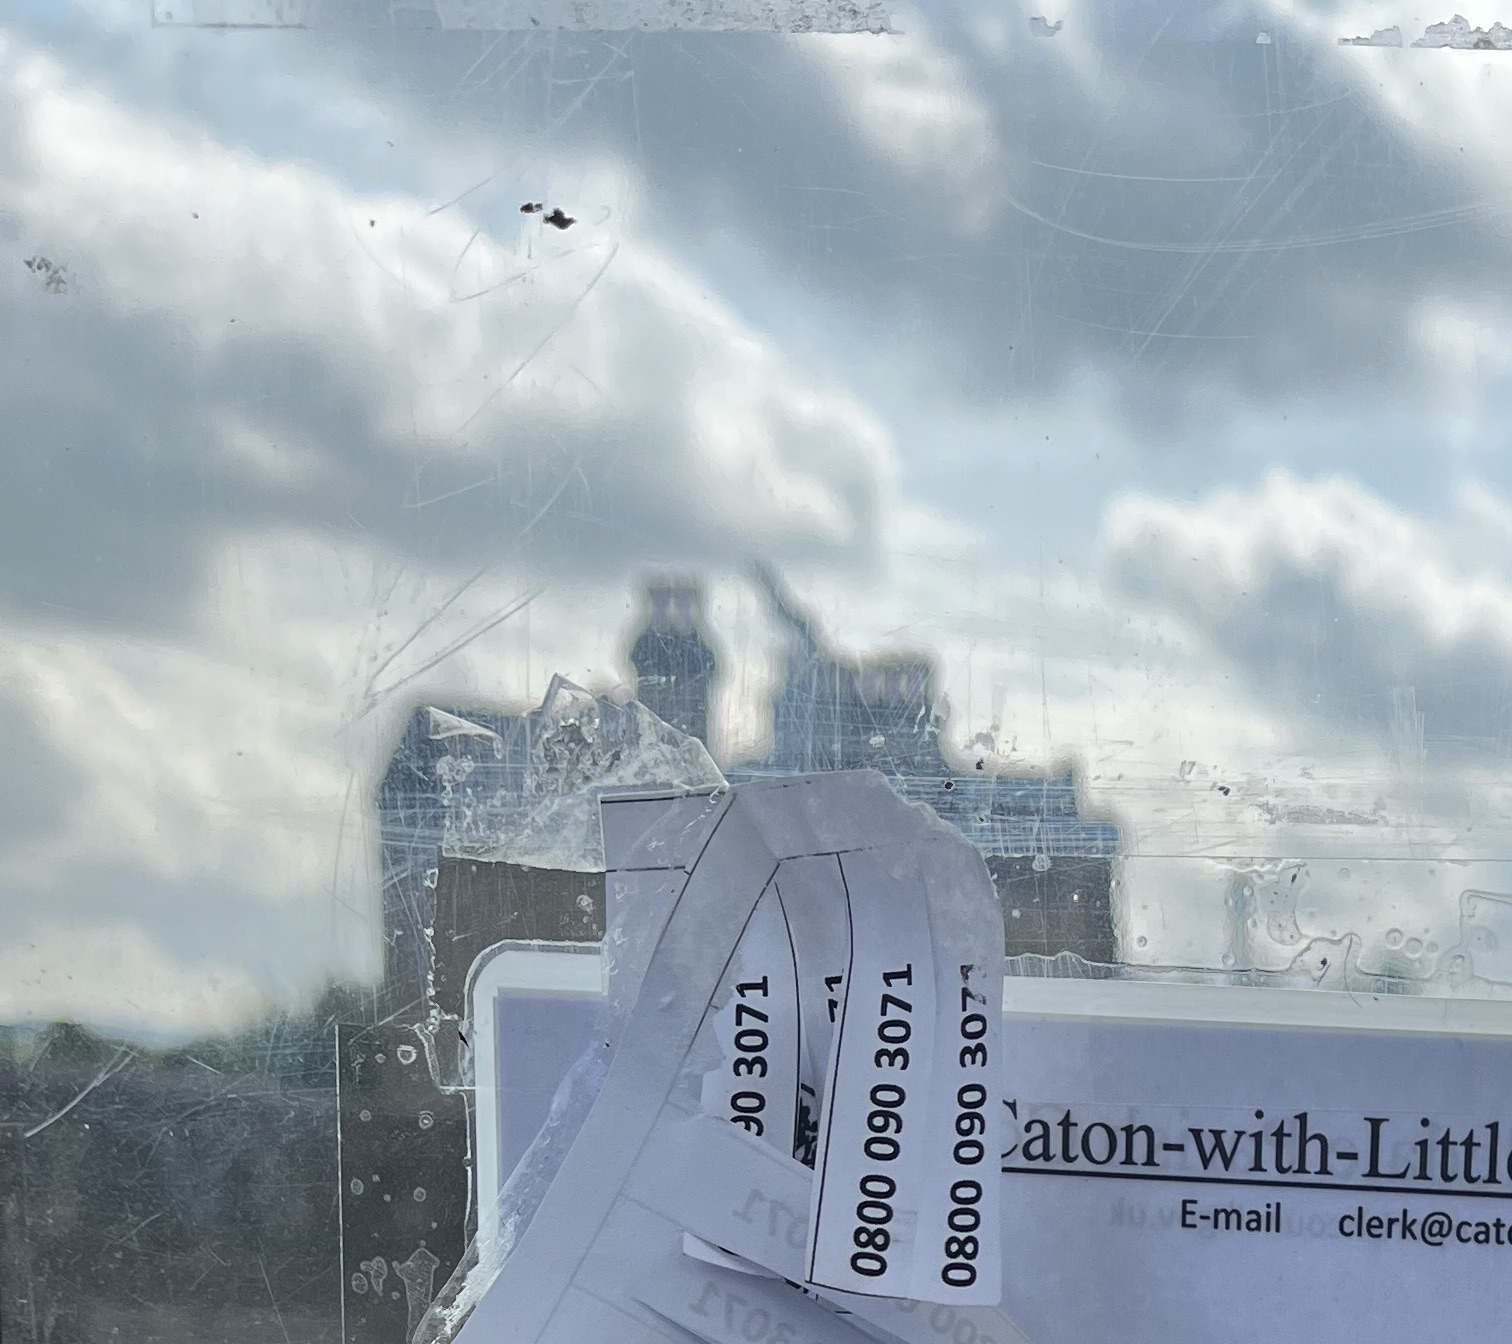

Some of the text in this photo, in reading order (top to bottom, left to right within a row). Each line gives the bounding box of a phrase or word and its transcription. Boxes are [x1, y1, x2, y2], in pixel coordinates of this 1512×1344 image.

[851, 964, 912, 1276] 0800 090 3071
[1181, 1200, 1281, 1233] E-mail
